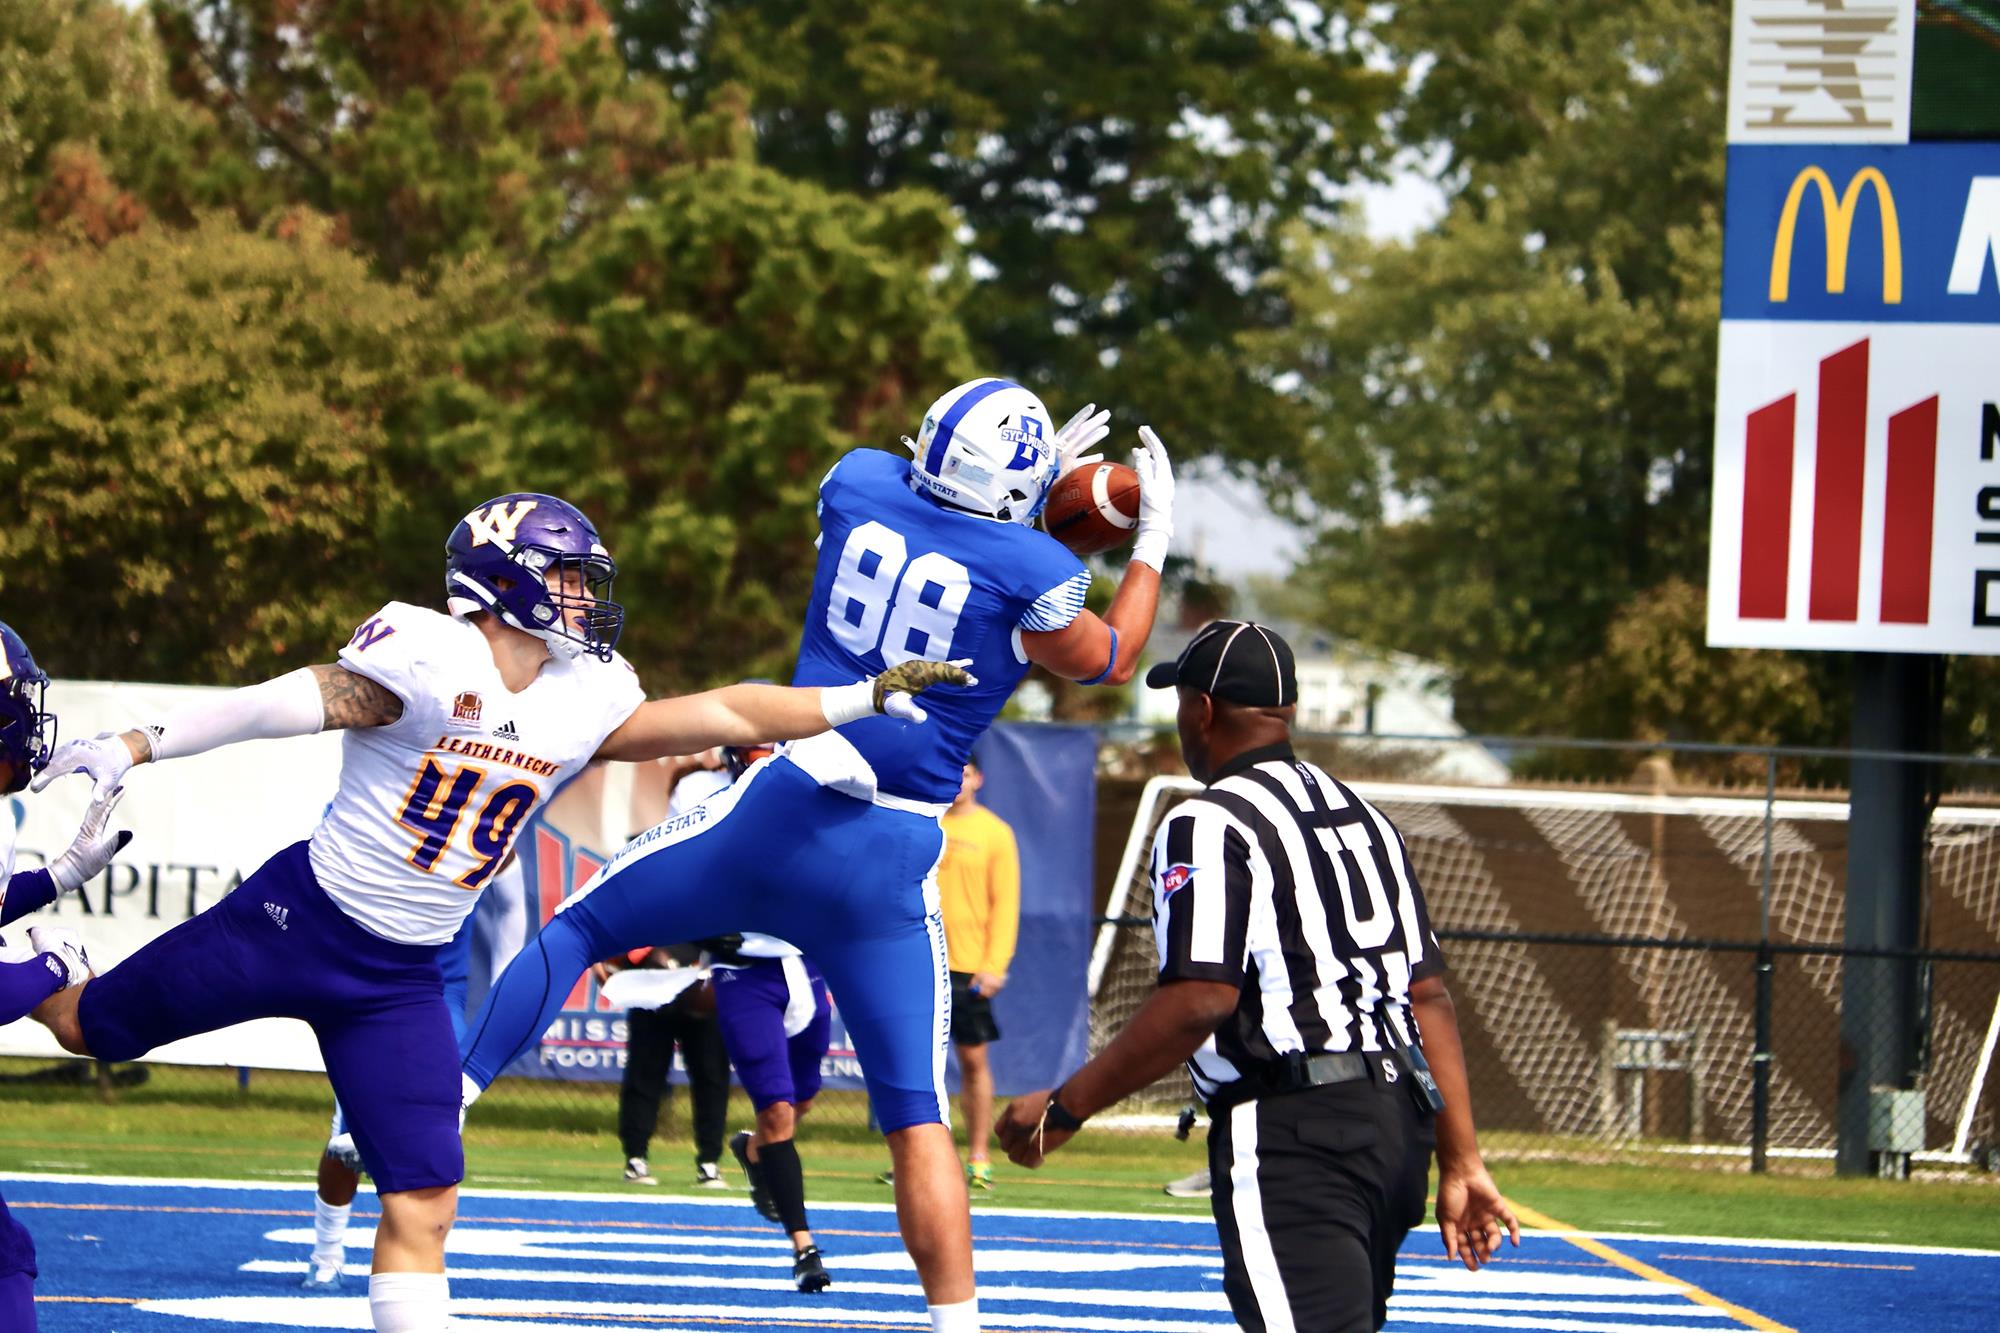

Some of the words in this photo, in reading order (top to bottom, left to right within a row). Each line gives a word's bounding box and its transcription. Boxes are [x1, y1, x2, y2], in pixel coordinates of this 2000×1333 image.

[932, 482, 958, 498] STATE
[464, 501, 539, 547] W
[827, 520, 972, 670] 88
[435, 735, 561, 777] LEATHERNECKS
[492, 730, 520, 741] adidas
[392, 752, 540, 890] 49
[1313, 822, 1395, 950] U
[263, 902, 289, 930] adidas
[541, 1018, 630, 1042] MISS
